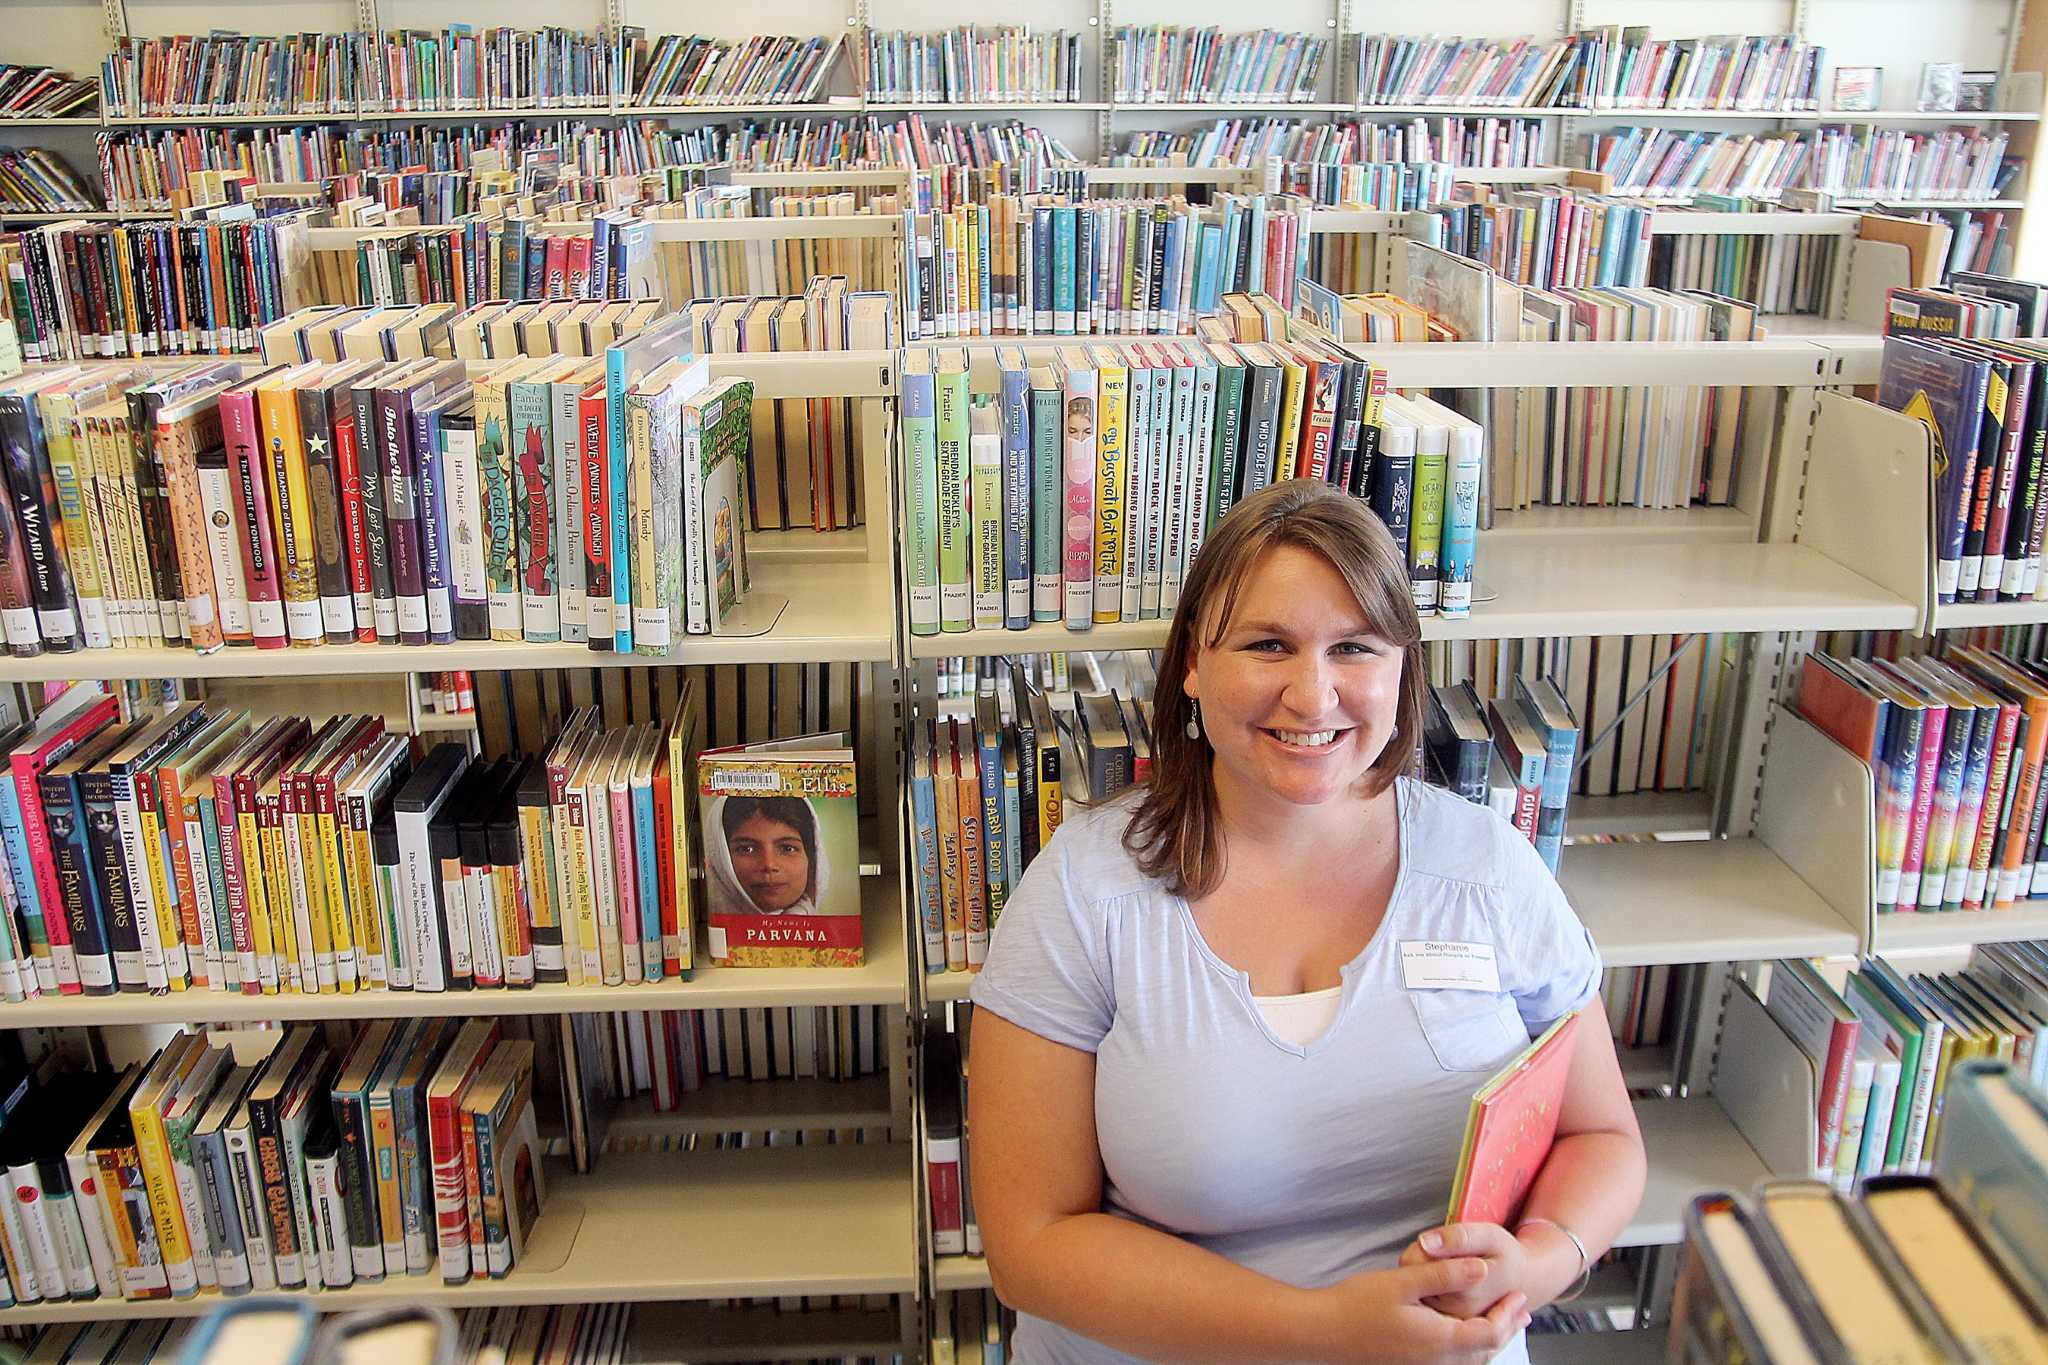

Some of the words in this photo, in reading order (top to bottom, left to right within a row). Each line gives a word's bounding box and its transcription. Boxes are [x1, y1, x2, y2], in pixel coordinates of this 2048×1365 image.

[943, 387, 953, 422] Frazier
[1227, 409, 1235, 425] WHO
[358, 404, 368, 450] DURRANT
[587, 416, 599, 460] TWELVE
[1226, 428, 1234, 436] IS
[1259, 421, 1269, 439] WHO
[1368, 431, 1375, 441] My
[2034, 430, 2046, 454] PURE
[565, 441, 576, 456] The
[950, 441, 959, 481] BRENDAN
[1223, 438, 1234, 472] STEALING
[1255, 442, 1267, 469] STOLE
[1285, 442, 1293, 459] THE
[1312, 432, 1327, 460] Gold
[455, 460, 464, 480] Half
[941, 441, 950, 497] SIXTH-GRADE
[1019, 449, 1027, 484] BRENDAN
[1102, 447, 1120, 504] Basmati
[1253, 471, 1264, 492] HALL
[1283, 463, 1291, 480] TRO
[362, 472, 378, 499] My
[456, 485, 465, 514] Magic
[486, 467, 504, 522] DAGGER
[985, 482, 993, 511] Frazier
[1010, 468, 1018, 513] EVERYTHING
[1130, 475, 1138, 511] MISSING
[1151, 482, 1159, 508] ROCK
[1173, 485, 1181, 510] RUBY
[1193, 477, 1203, 519] DIAMOND
[1221, 489, 1229, 497] 12
[242, 473, 254, 512] PROPHET
[250, 530, 262, 568] YONWOOD
[278, 471, 289, 510] DIAMOND
[284, 523, 296, 565] DARKHOLD
[364, 502, 382, 531] Last
[952, 484, 960, 528] BUCKLEY'S
[641, 509, 650, 541] Mandy
[943, 500, 951, 550] EXPERIMENT
[990, 520, 998, 551] BRENDAN
[1101, 509, 1120, 535] Bat
[1128, 514, 1136, 558] DINOSAUR
[1170, 513, 1179, 556] SLIPPERS
[1192, 522, 1200, 539] DOG
[22, 504, 44, 560] WIZARD
[36, 561, 48, 592] Alone
[368, 532, 384, 568] Skirt
[982, 520, 990, 565] SIXTH-GRADE
[1127, 561, 1135, 577] EGG
[1148, 553, 1156, 571] DOG
[19, 775, 30, 792] THE
[803, 777, 847, 792] Ellis
[987, 761, 995, 789] FRIEND
[985, 797, 1001, 834] BARN
[105, 845, 116, 864] THE
[221, 825, 236, 871] Discovery
[1911, 816, 1926, 863] Summer
[4, 824, 32, 913] Francie
[61, 849, 71, 869] THE
[124, 831, 141, 896] BIRCHBARK
[192, 851, 202, 868] THE
[990, 841, 1001, 873] BOOT
[195, 871, 208, 900] GAME
[228, 874, 237, 883] at
[61, 870, 86, 931] FAMILIARS
[105, 865, 129, 928] FAMILIARS
[172, 849, 197, 939] CHICKADEE
[200, 902, 209, 916] OF
[230, 887, 243, 908] Flint
[202, 918, 214, 949] SILENC
[232, 912, 247, 947] Springs
[747, 929, 827, 942] PARVANA
[152, 1176, 168, 1206] VALUE
